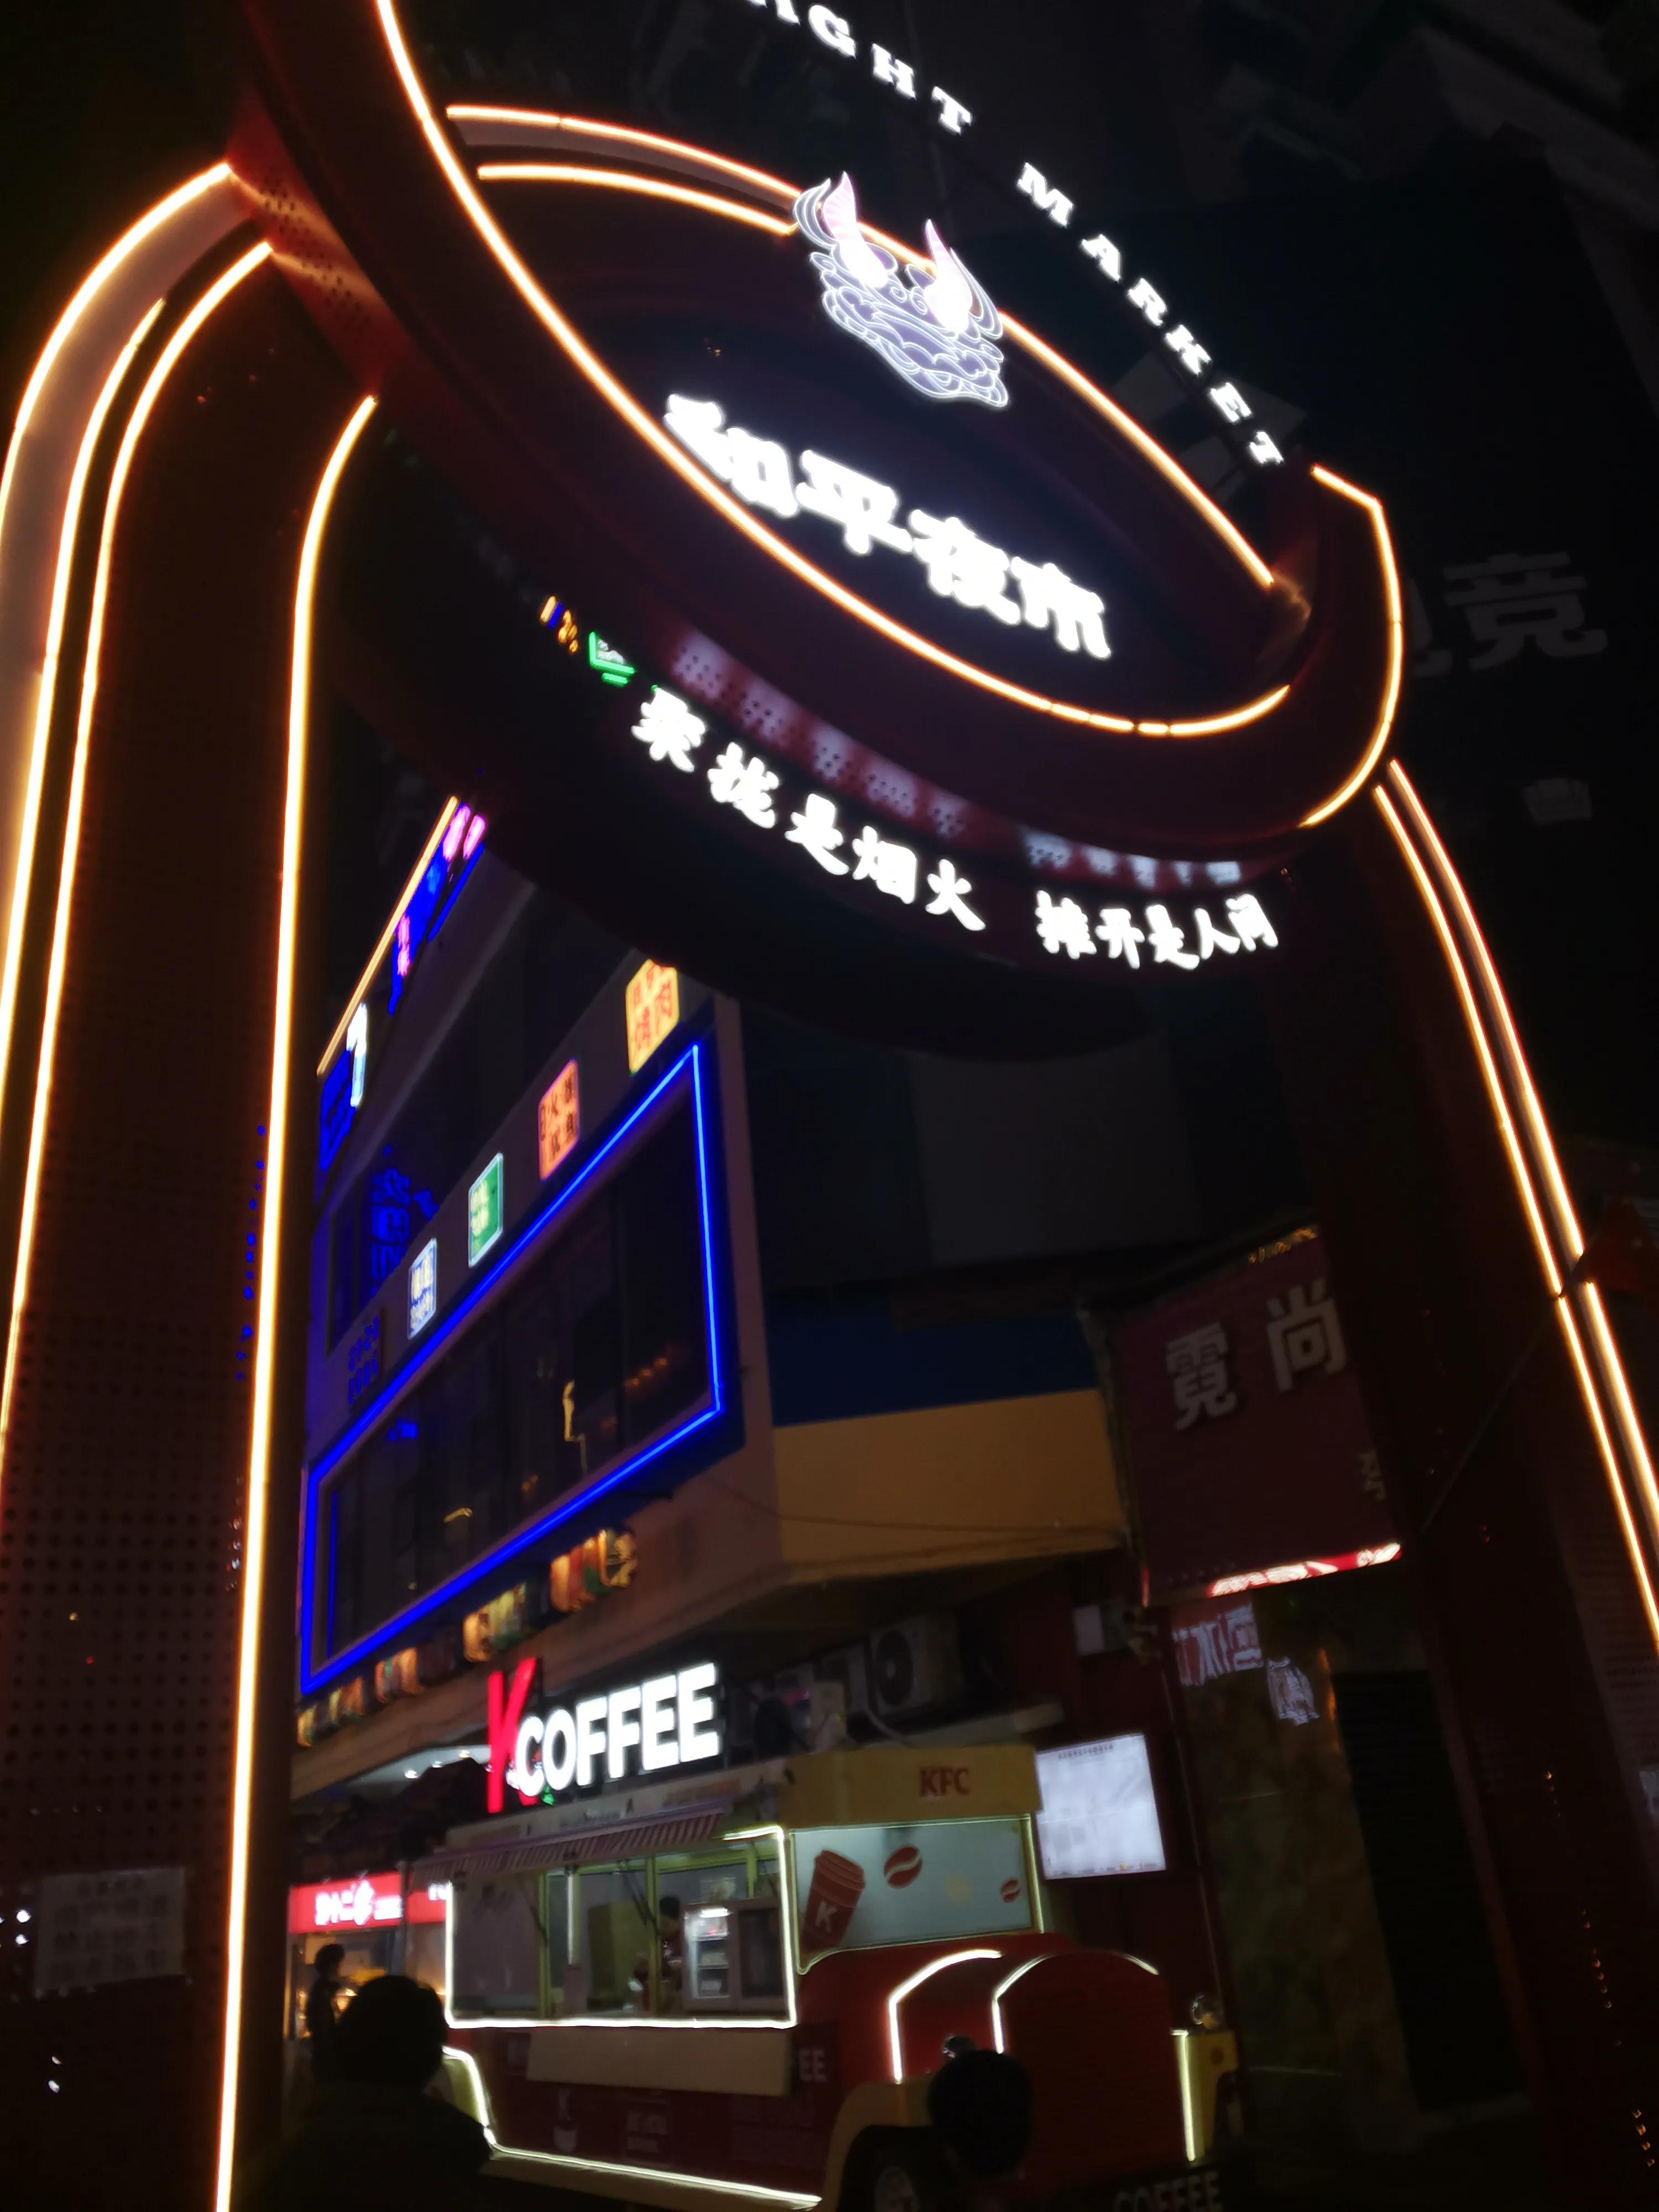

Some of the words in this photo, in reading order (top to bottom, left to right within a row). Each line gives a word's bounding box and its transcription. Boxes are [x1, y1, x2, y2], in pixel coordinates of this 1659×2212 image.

[1017, 162, 1284, 466] MARKET
[665, 394, 1111, 659] 和平夜市
[632, 687, 986, 931] 聚拢是烟火
[1035, 889, 1279, 969] 摊开是人间
[919, 1767, 971, 1797] KFC
[815, 1900, 838, 1935] K
